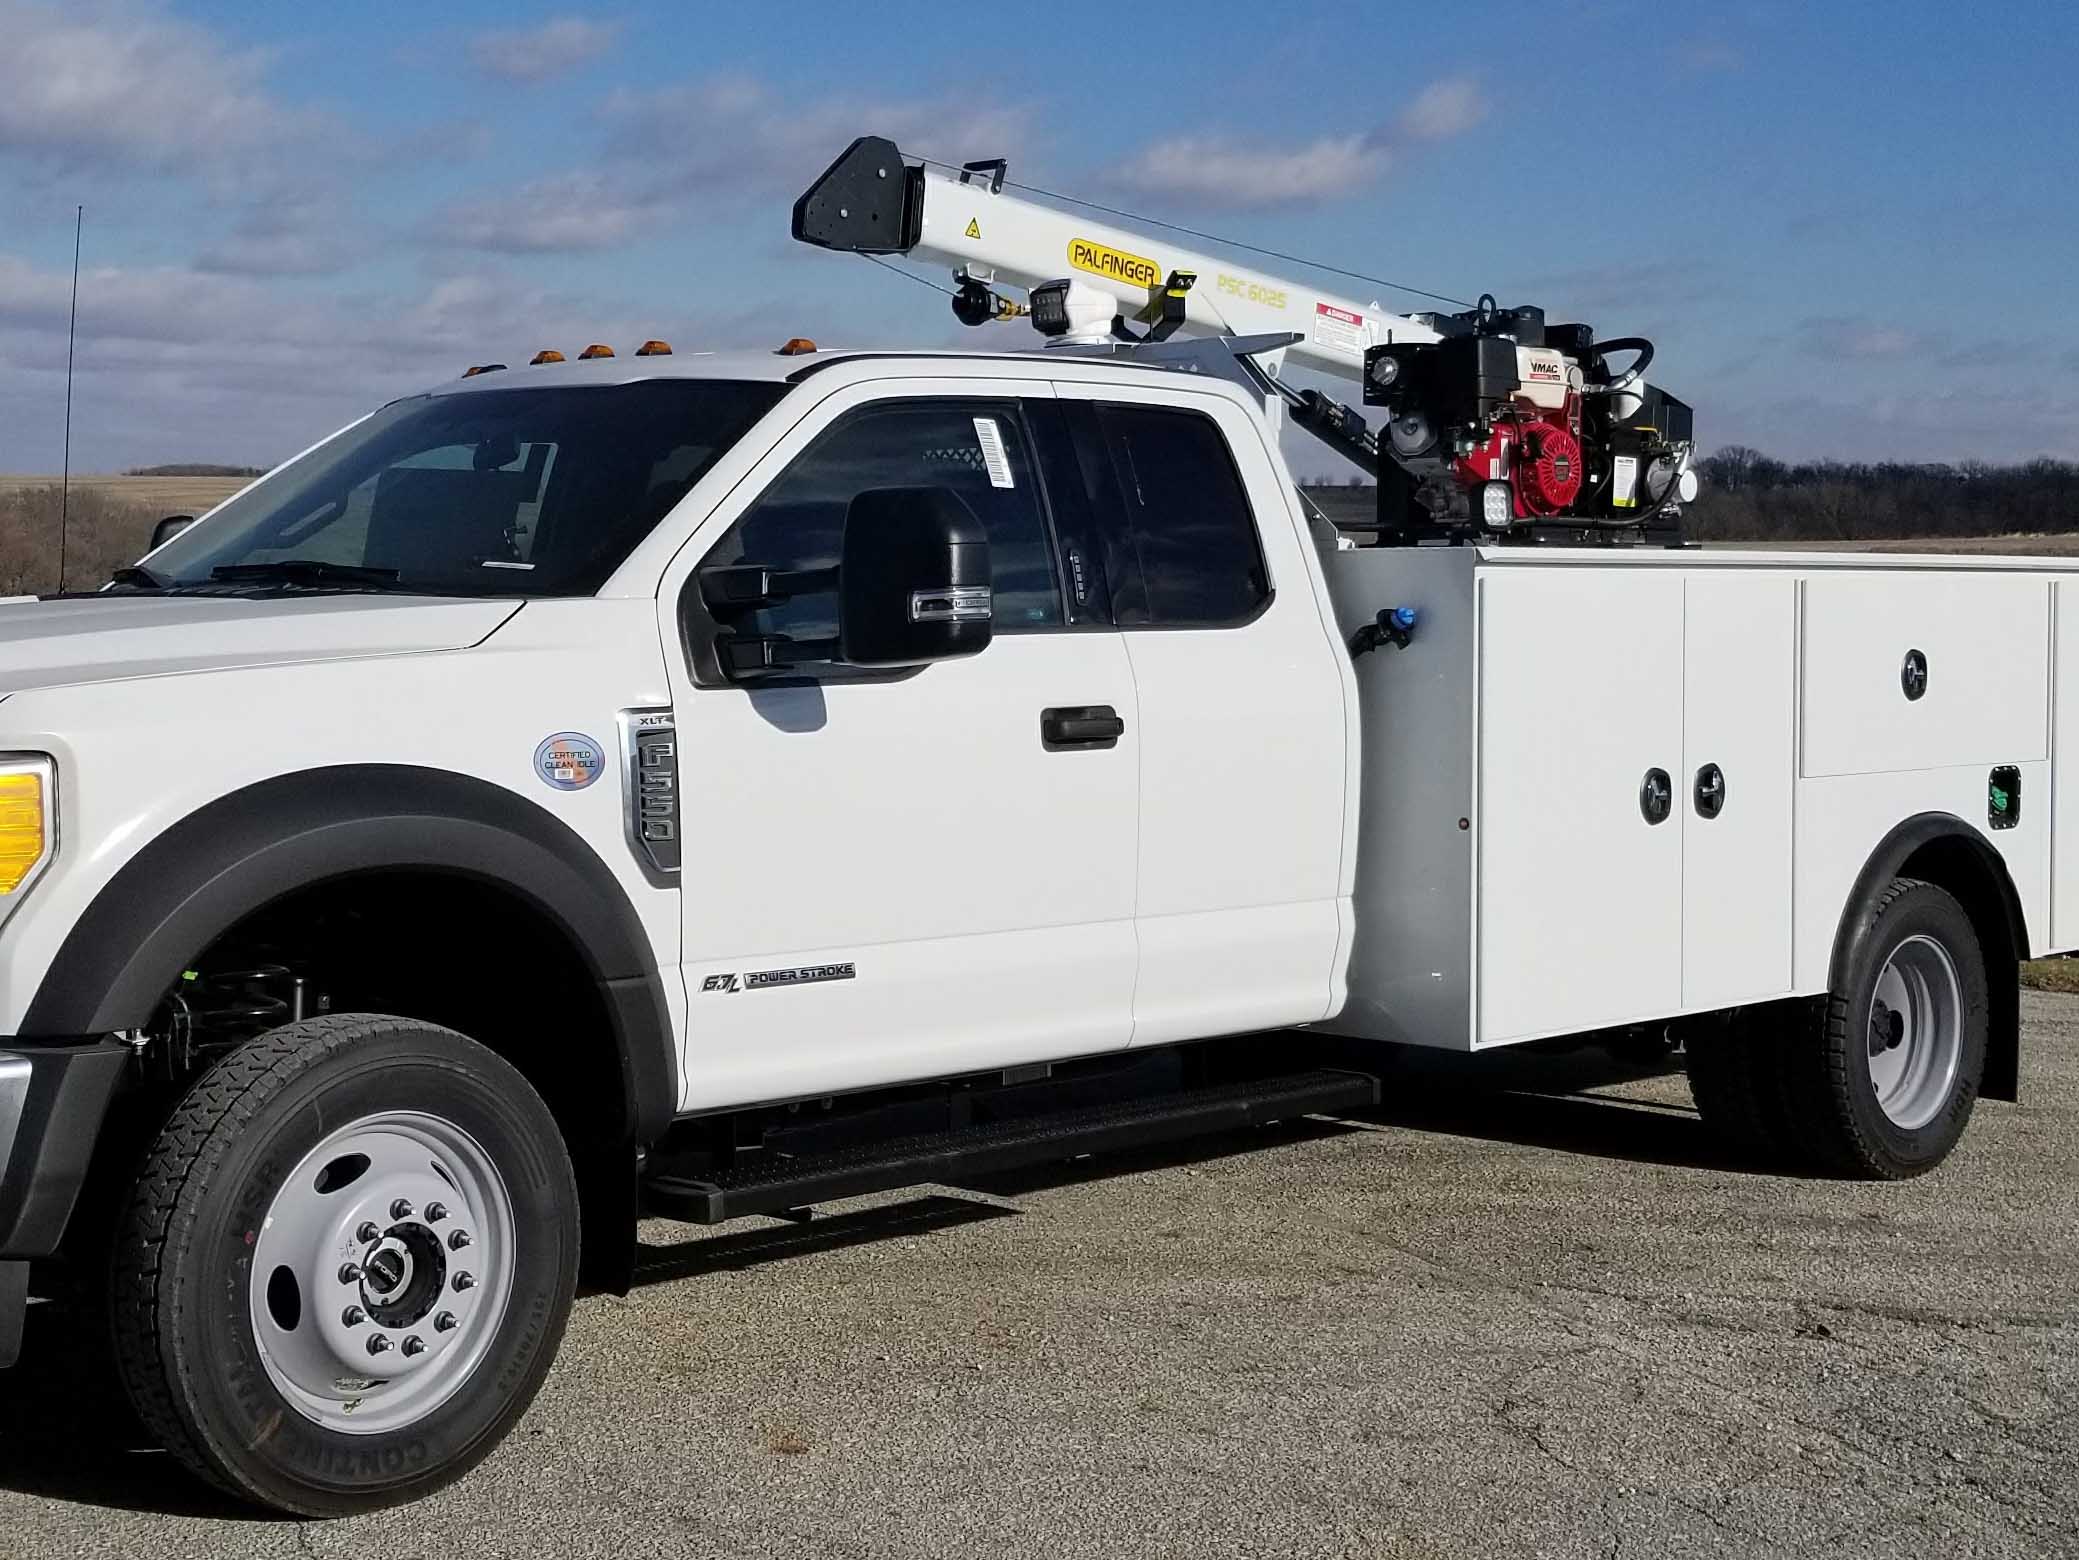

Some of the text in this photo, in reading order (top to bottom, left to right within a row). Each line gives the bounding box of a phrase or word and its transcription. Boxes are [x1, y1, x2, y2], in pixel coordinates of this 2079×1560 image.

[1073, 244, 1155, 285] PALFINGER
[1217, 273, 1287, 309] PSC 6025
[1530, 361, 1559, 374] VMAC
[640, 715, 664, 725] XLT
[548, 750, 591, 760] CERTIFIED
[544, 760, 596, 769] CLEAN IDLE
[701, 963, 854, 993] 6.7L POWER STROKE
